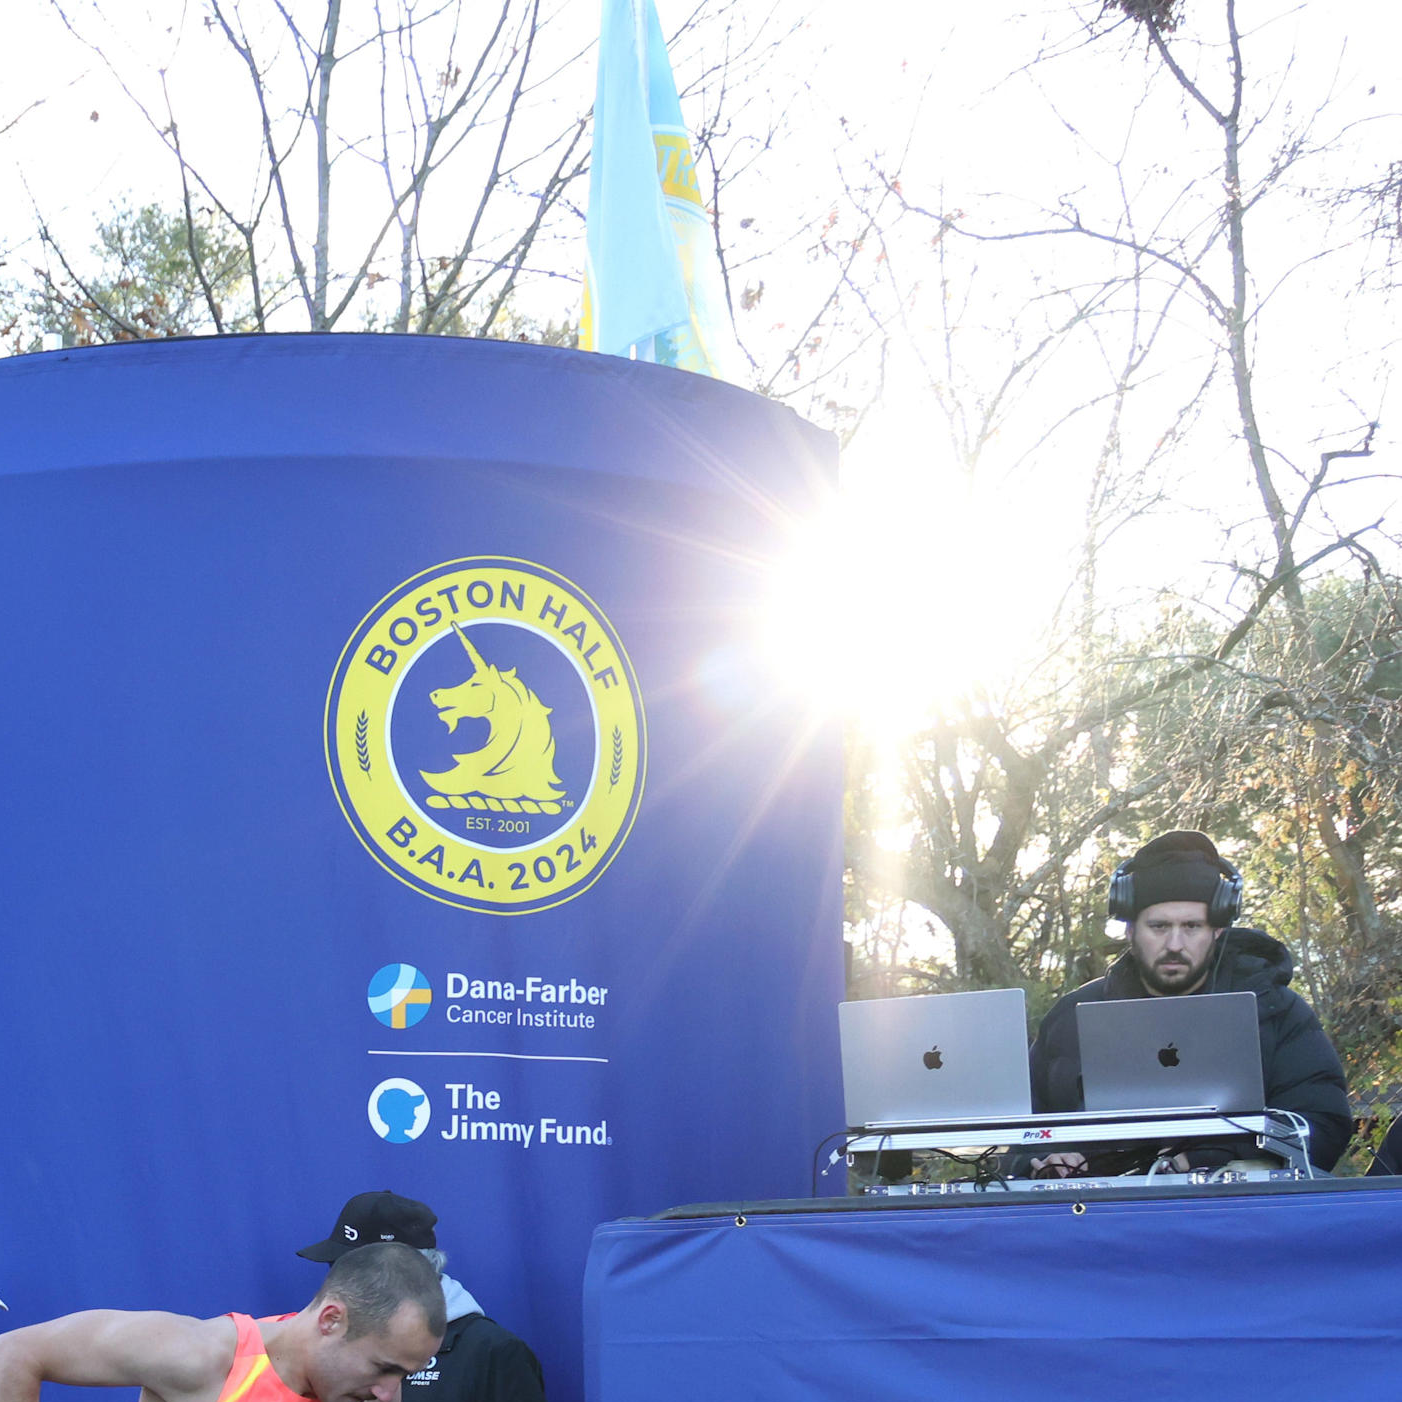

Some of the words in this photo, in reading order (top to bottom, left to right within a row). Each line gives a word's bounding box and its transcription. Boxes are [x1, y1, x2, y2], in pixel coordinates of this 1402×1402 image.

[364, 579, 526, 676] BOSTON
[538, 594, 619, 690] HALF
[466, 817, 494, 831] EST.
[497, 818, 531, 834] 2001
[385, 815, 495, 889] B.A.A.
[507, 826, 597, 891] 2024
[446, 972, 608, 1006] Dana-Farber
[446, 1004, 513, 1025] Cancer
[516, 1007, 595, 1029] Institute
[445, 1083, 501, 1110] The
[441, 1114, 535, 1148] Jimmy
